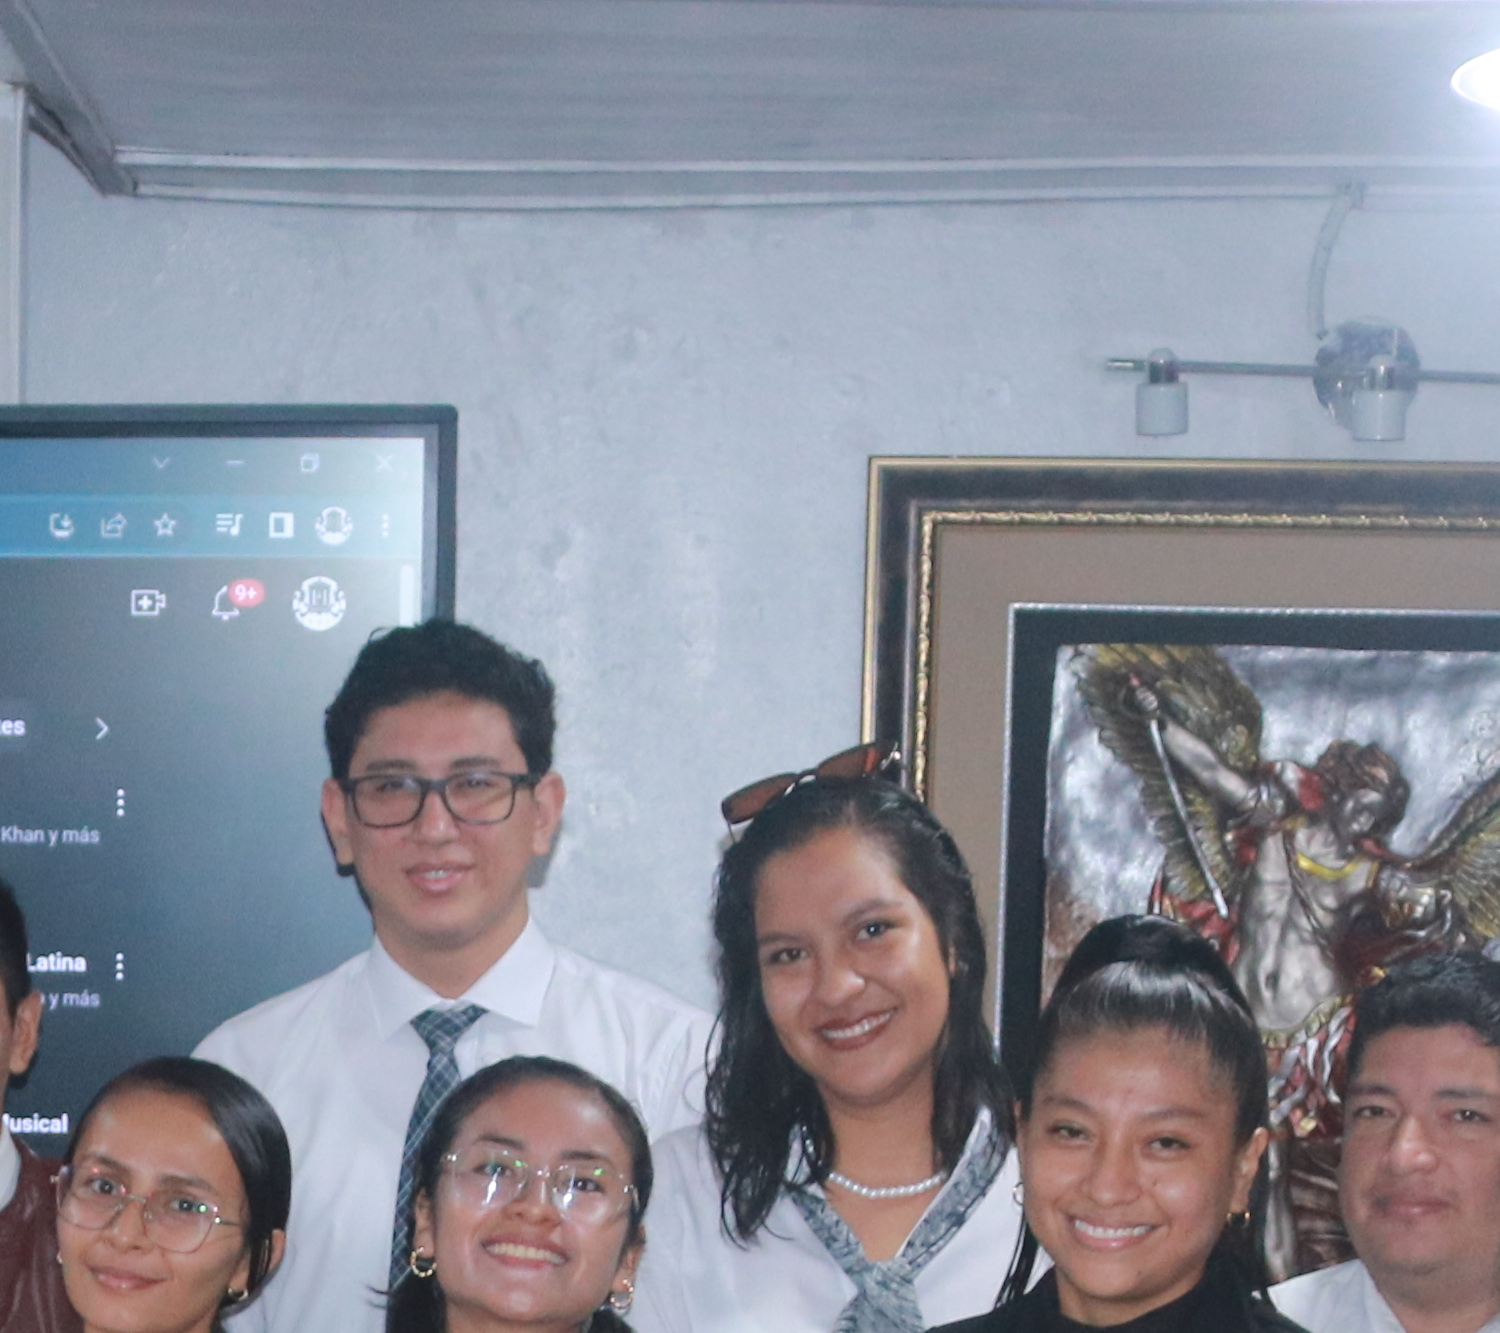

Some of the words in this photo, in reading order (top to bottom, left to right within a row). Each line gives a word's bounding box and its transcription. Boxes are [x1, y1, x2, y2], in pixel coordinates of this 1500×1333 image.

[234, 584, 258, 601] 9+
[1, 824, 44, 844] Khan
[47, 829, 59, 847] y
[62, 824, 99, 844] más
[47, 993, 58, 1010] y
[62, 989, 100, 1008] más
